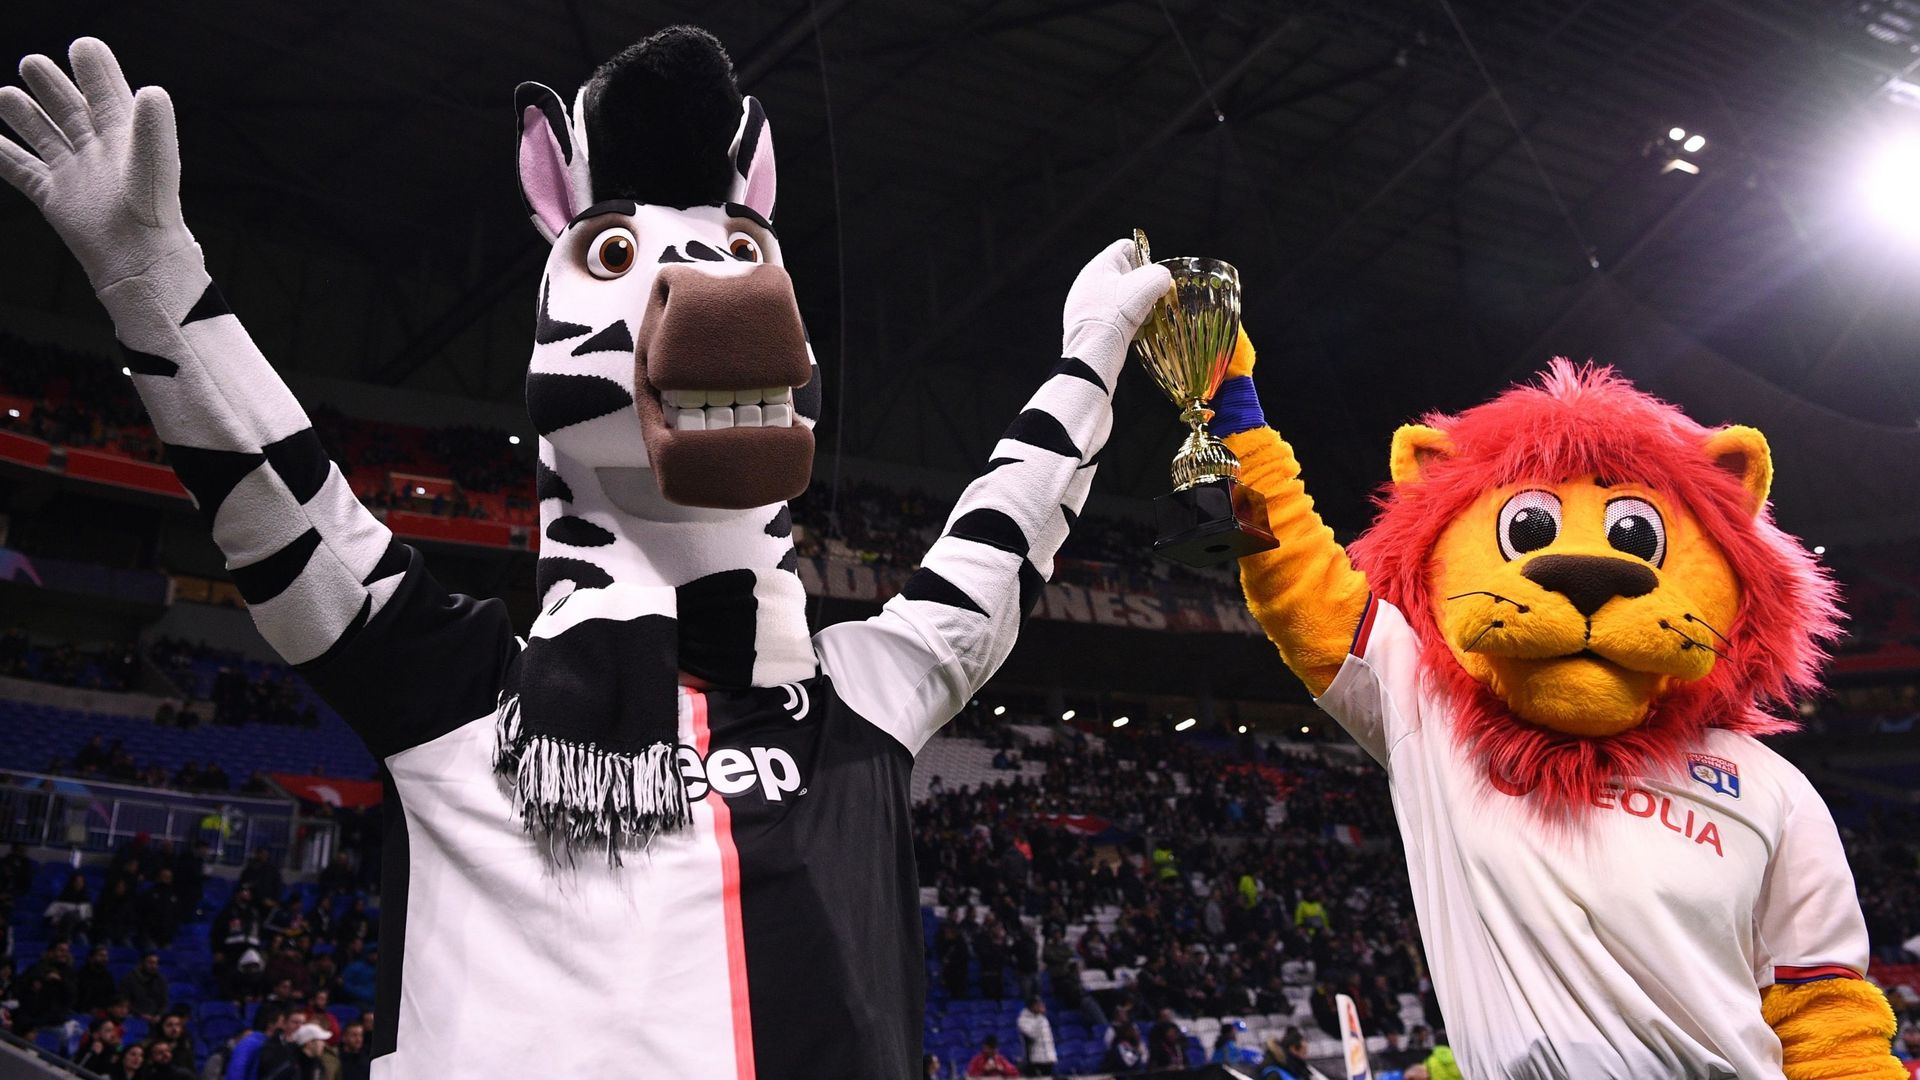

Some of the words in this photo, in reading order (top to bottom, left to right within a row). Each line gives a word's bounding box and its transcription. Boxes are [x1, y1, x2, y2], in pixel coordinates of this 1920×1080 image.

[1030, 583, 1168, 629] NES
[677, 746, 801, 801] eep
[1592, 781, 1723, 857] EOLIA
